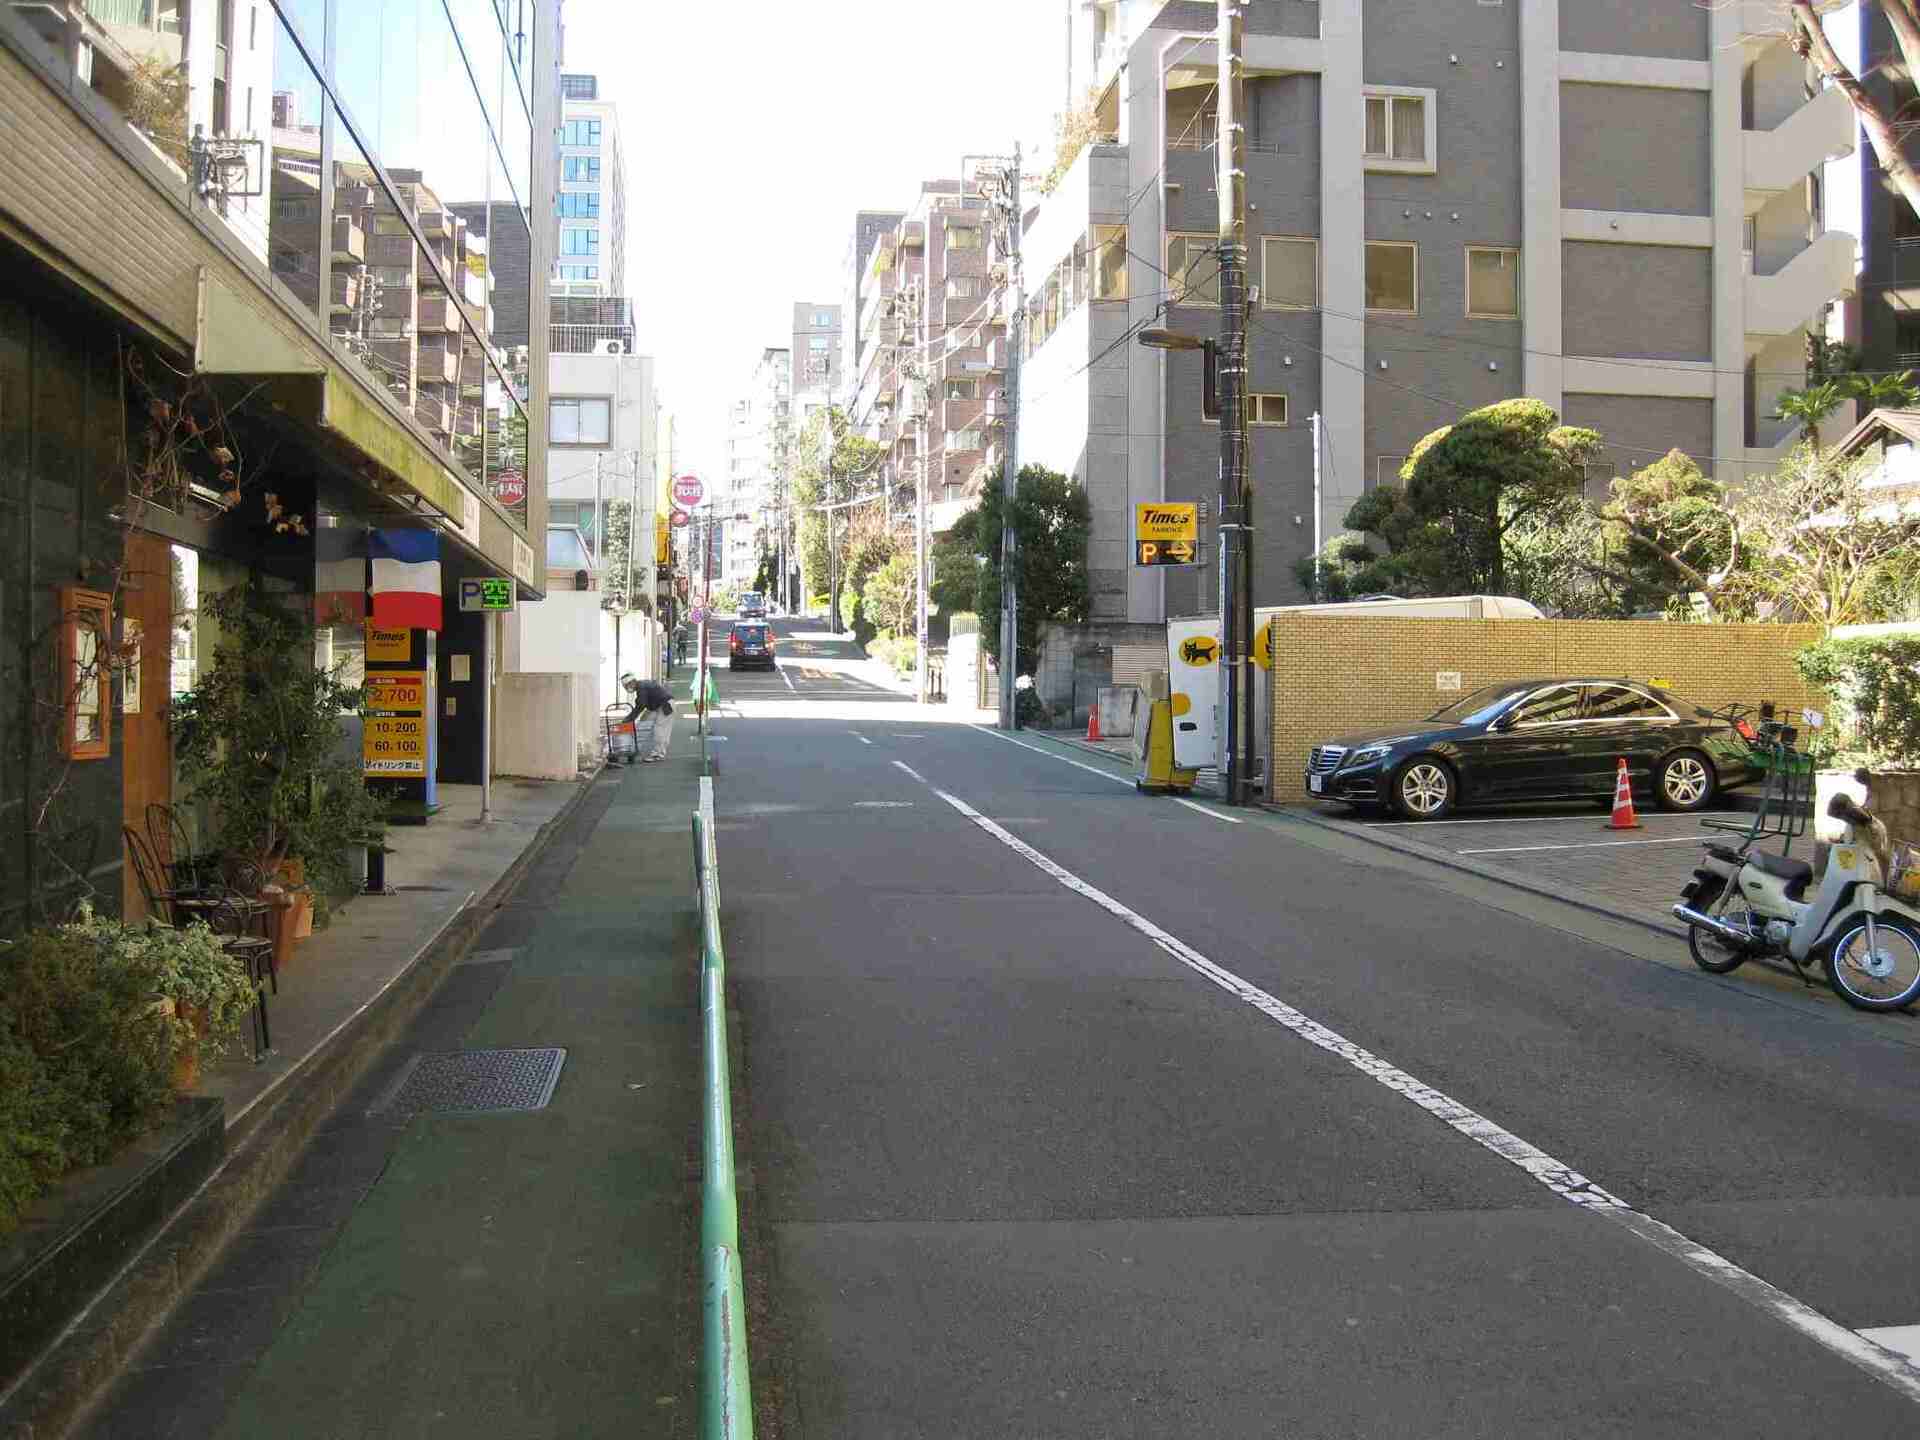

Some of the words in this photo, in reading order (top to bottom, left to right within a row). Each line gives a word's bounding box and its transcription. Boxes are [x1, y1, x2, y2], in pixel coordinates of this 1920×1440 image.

[1143, 510, 1191, 524] Times
[1142, 542, 1158, 565] P
[462, 582, 481, 608] P
[371, 630, 407, 641] Times
